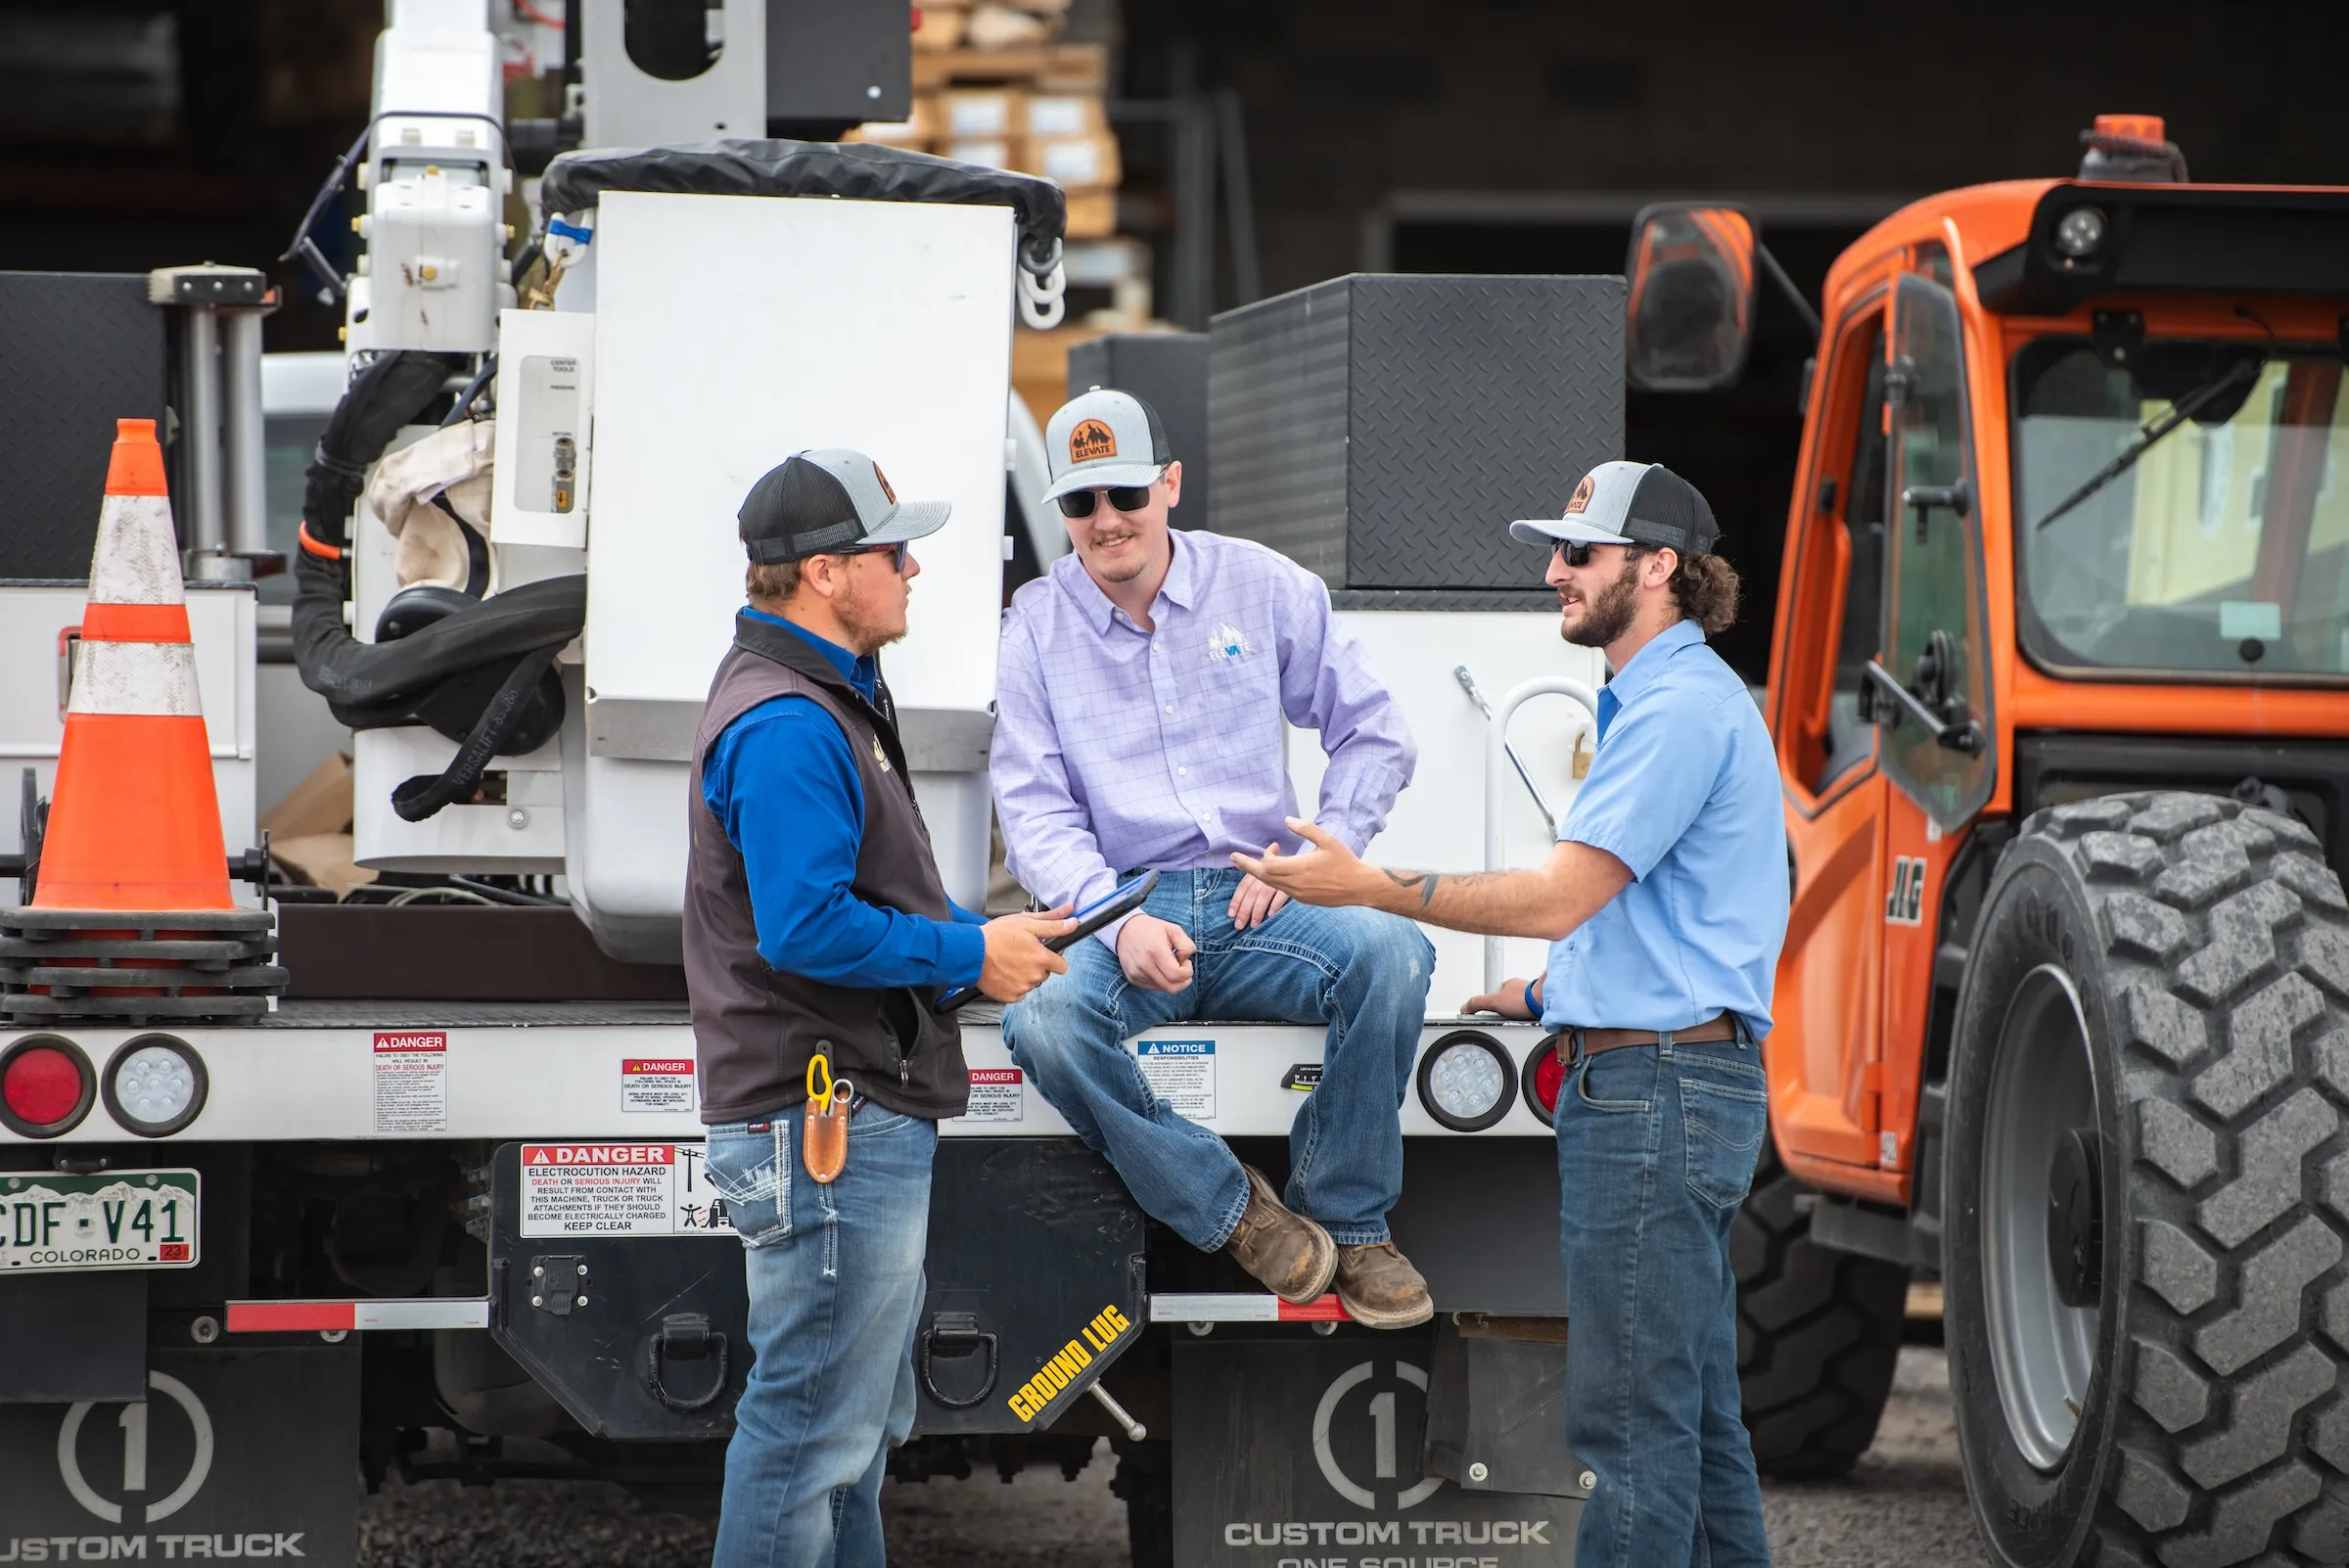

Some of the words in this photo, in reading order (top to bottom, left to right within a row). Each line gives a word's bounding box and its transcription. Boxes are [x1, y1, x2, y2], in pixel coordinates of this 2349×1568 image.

[1076, 445, 1110, 458] ELEVATE
[1210, 642, 1251, 662] ELEVATE
[391, 1037, 442, 1048] DANGER
[1162, 1044, 1206, 1053] NOTICE
[556, 1147, 666, 1164] DANGER
[529, 1168, 619, 1176] ELECTROCUTION
[622, 1167, 667, 1176] HAZARD
[528, 1212, 563, 1221] BECOME
[564, 1212, 623, 1221] ELECTRICALLY
[625, 1212, 668, 1221] CHARGED.
[564, 1222, 593, 1230] KEEP
[595, 1222, 631, 1230] CLEAR
[30, 1247, 140, 1264] COLORADO
[1007, 1339, 1093, 1423] GROUND
[1082, 1304, 1131, 1353] LUG
[1224, 1521, 1401, 1546] CUSTOM
[1407, 1520, 1551, 1545] TRUCK
[0, 1535, 147, 1561] USTOM
[157, 1533, 305, 1558] TRUCK
